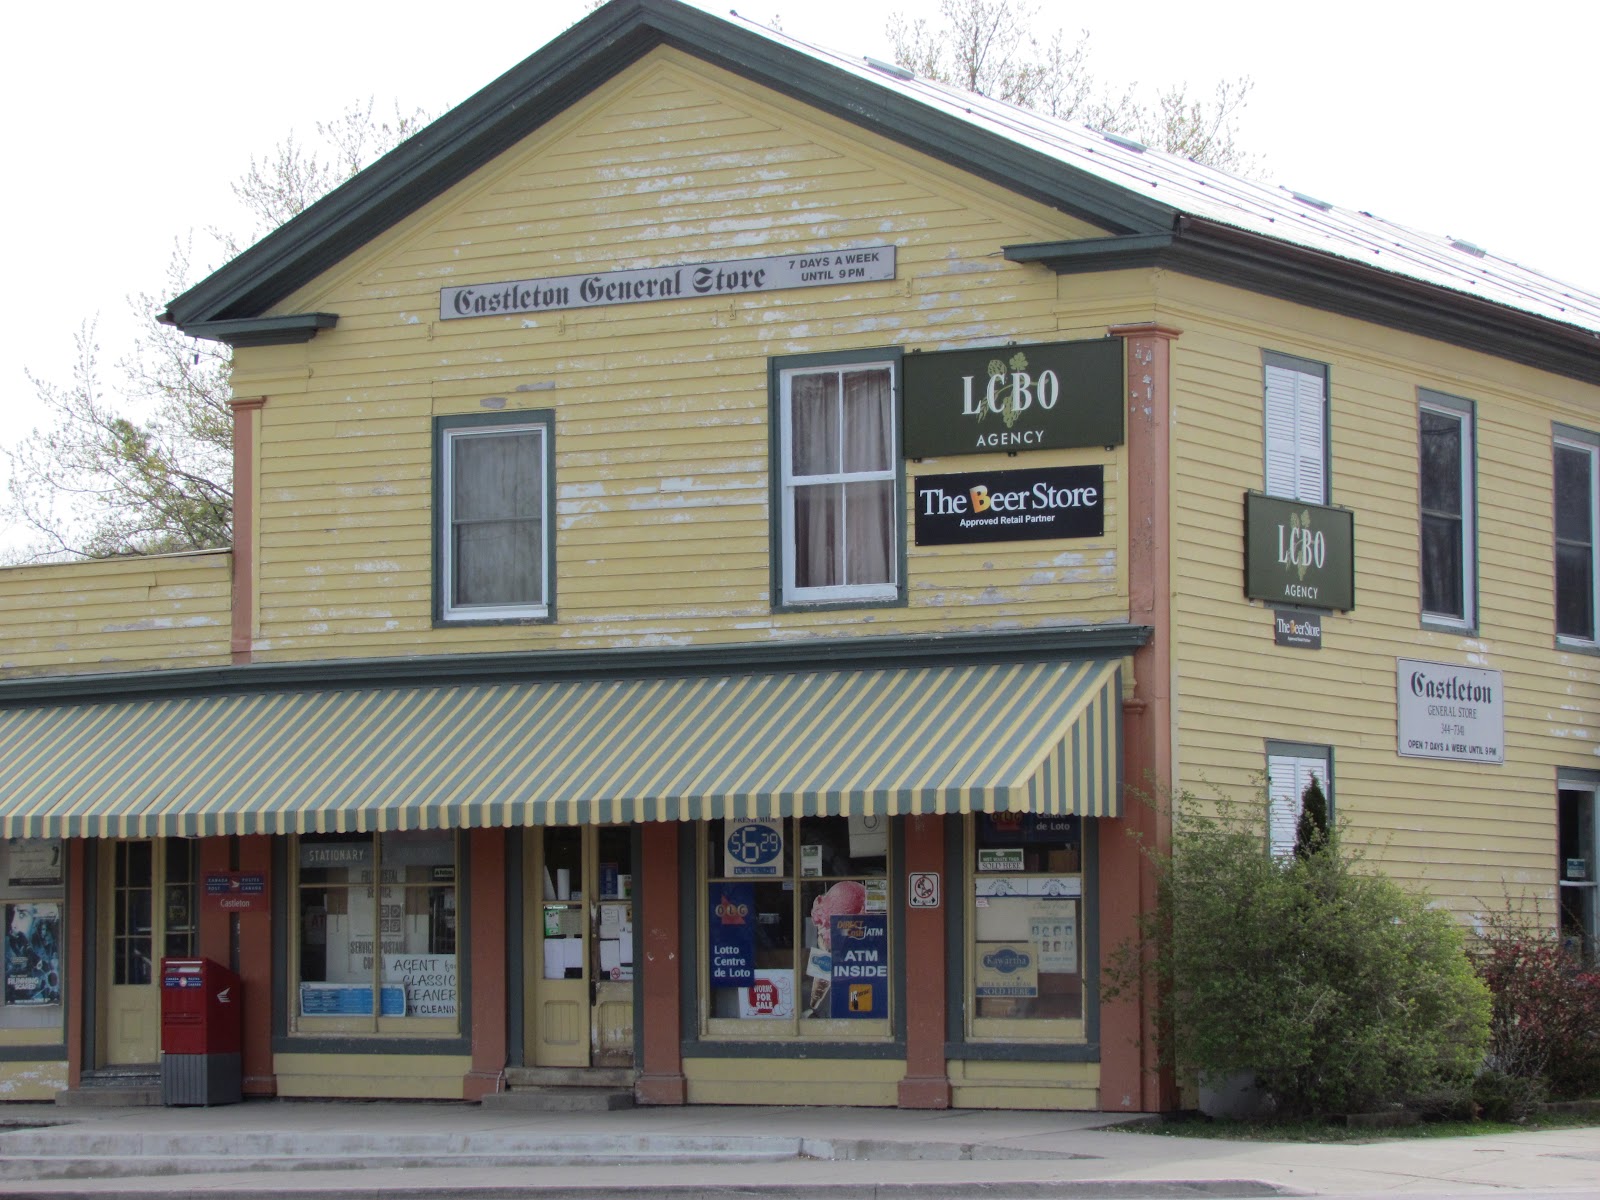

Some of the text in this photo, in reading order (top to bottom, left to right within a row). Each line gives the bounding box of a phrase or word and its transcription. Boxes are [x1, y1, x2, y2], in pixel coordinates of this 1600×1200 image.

[789, 252, 880, 270] 7 DAYS A WEEK
[801, 270, 834, 282] UNTIL
[453, 267, 766, 315] Castleton General Store
[961, 369, 1059, 415] LCBO
[976, 430, 1045, 447] AGENCY
[919, 482, 1097, 515] The Beer Store
[959, 514, 1055, 528] Approved Retail Partner
[1277, 524, 1325, 569] LCBO
[1284, 584, 1318, 599] AGENCY
[1277, 618, 1291, 634] The
[1304, 621, 1320, 637] Store
[1410, 671, 1492, 704] Castleton
[1427, 704, 1477, 720] GENERAL STORE
[1408, 739, 1423, 749] OPEN
[1424, 741, 1428, 749] 7
[1429, 742, 1444, 751] DAYS
[1445, 743, 1449, 751] A
[1451, 743, 1467, 753] WEEK
[1468, 745, 1483, 755] UNTIL
[1036, 822, 1071, 831] de Loto
[309, 848, 364, 862] STATIONARY
[982, 862, 1002, 870] SOLD
[220, 898, 250, 908] Castleton
[837, 920, 864, 929] DIRECT
[866, 928, 883, 937] ATM
[714, 945, 740, 955] Lotto
[844, 950, 878, 962] ATM
[714, 956, 746, 966] Centre
[987, 955, 1026, 965] Kawartha
[393, 959, 440, 974] AGENT
[833, 965, 887, 977] INSIDE
[714, 968, 751, 978] de Loto
[402, 974, 456, 987] CLASSIC
[407, 988, 456, 1001] LEANER
[754, 984, 773, 993] WORMS
[983, 987, 1029, 995] SOLD HERE
[756, 993, 772, 1001] FOR
[407, 1004, 456, 1014] RY CLEANIN
[756, 1001, 773, 1009] SALE
